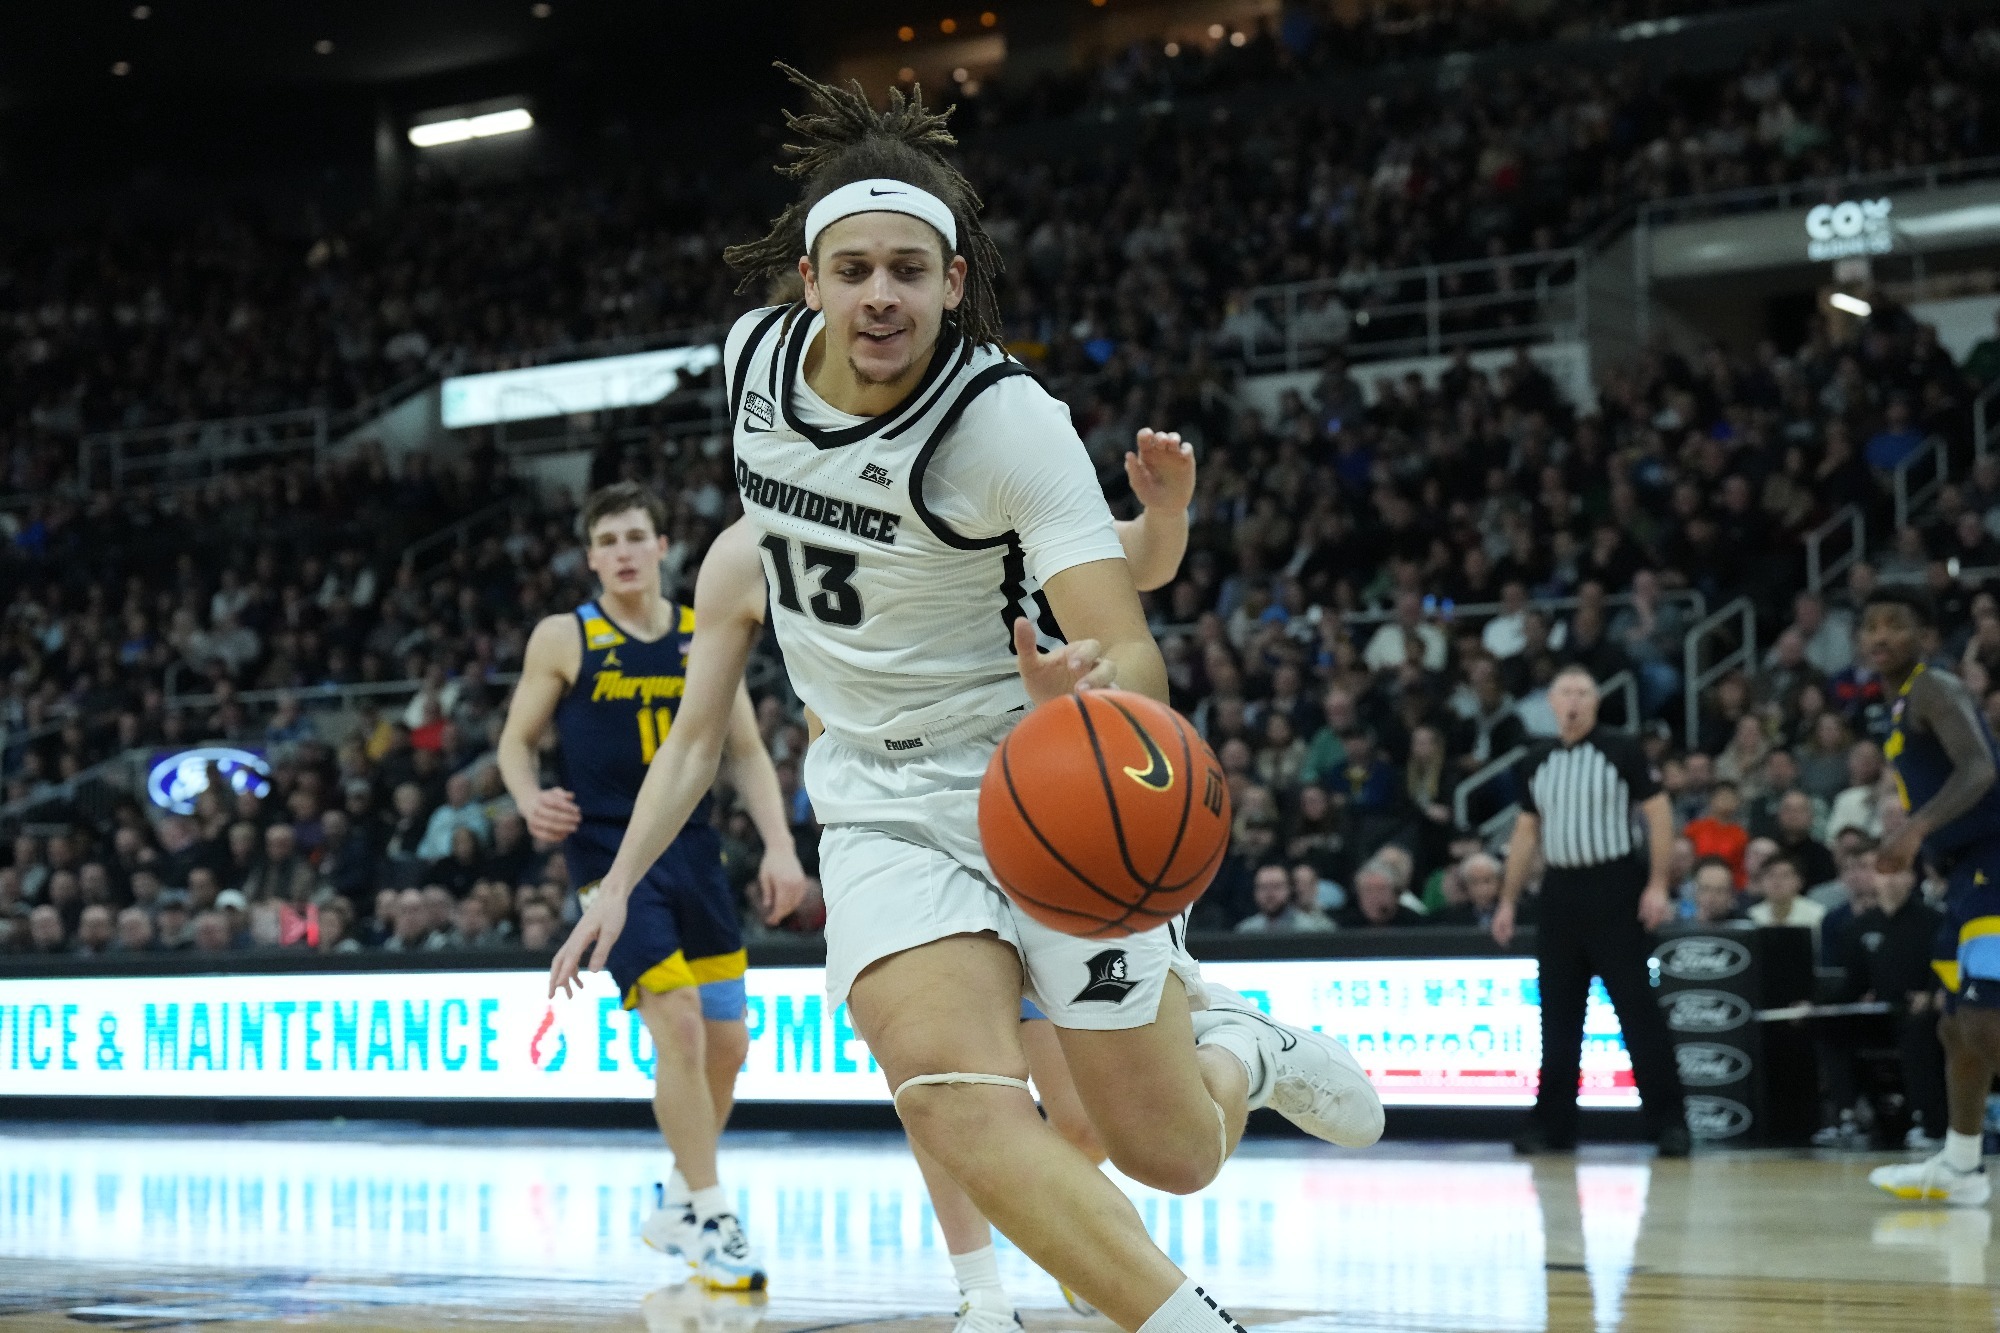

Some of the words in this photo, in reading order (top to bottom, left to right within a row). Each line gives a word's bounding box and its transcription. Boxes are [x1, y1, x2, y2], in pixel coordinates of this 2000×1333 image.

[861, 468, 894, 487] EAST
[865, 462, 889, 477] BIG
[757, 531, 865, 629] 13
[884, 738, 924, 751] FRIARS
[97, 1010, 124, 1071] &
[143, 1000, 499, 1072] MAINTENANCE
